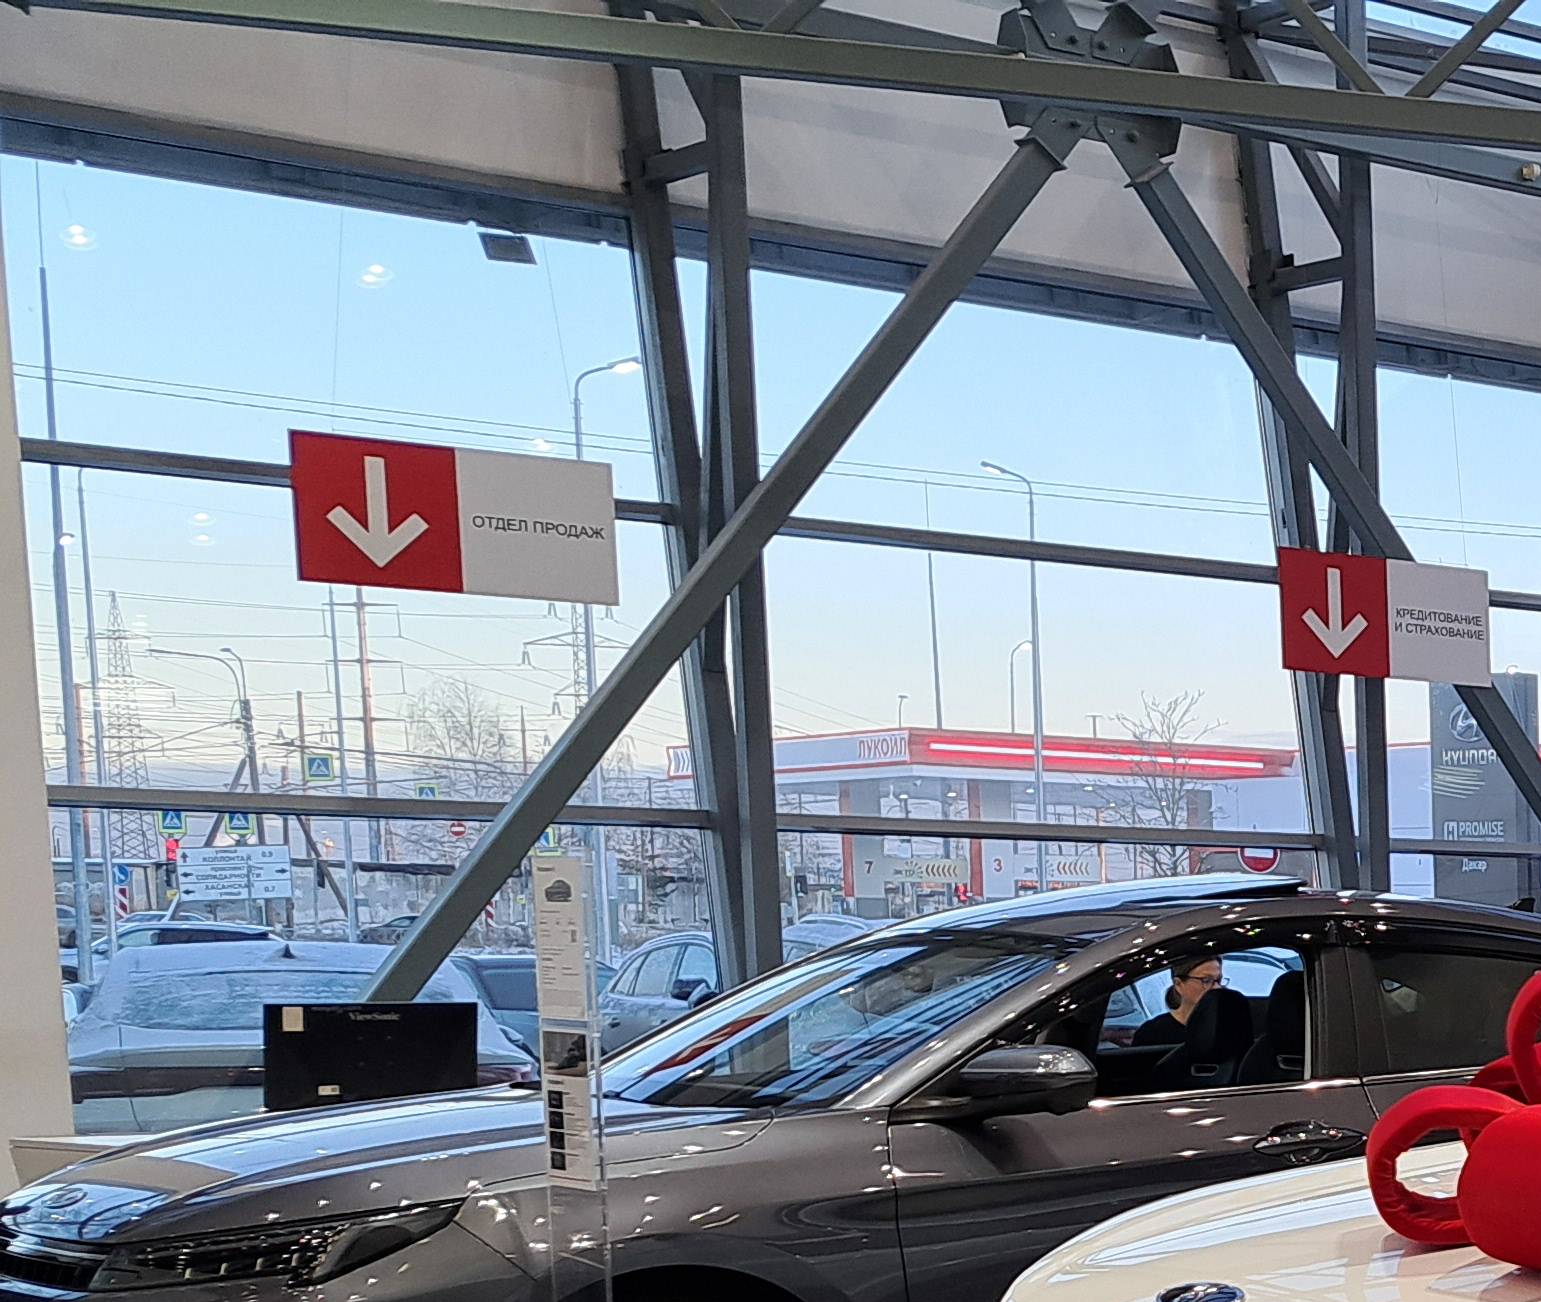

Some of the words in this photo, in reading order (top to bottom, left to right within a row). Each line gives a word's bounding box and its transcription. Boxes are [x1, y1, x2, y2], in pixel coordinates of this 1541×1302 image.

[472, 515, 528, 533] ОТДЕЛ
[532, 520, 606, 540] ПРОДАЖ
[1395, 607, 1482, 626] КРЕДИТОВАНИЕ
[1394, 621, 1402, 632] И
[1405, 622, 1485, 640] СТРАХОВАНИЕ
[1459, 821, 1504, 836] PROMISE
[864, 860, 874, 874] 7
[993, 858, 1003, 872] 3
[349, 1012, 400, 1021] ViewSonic
